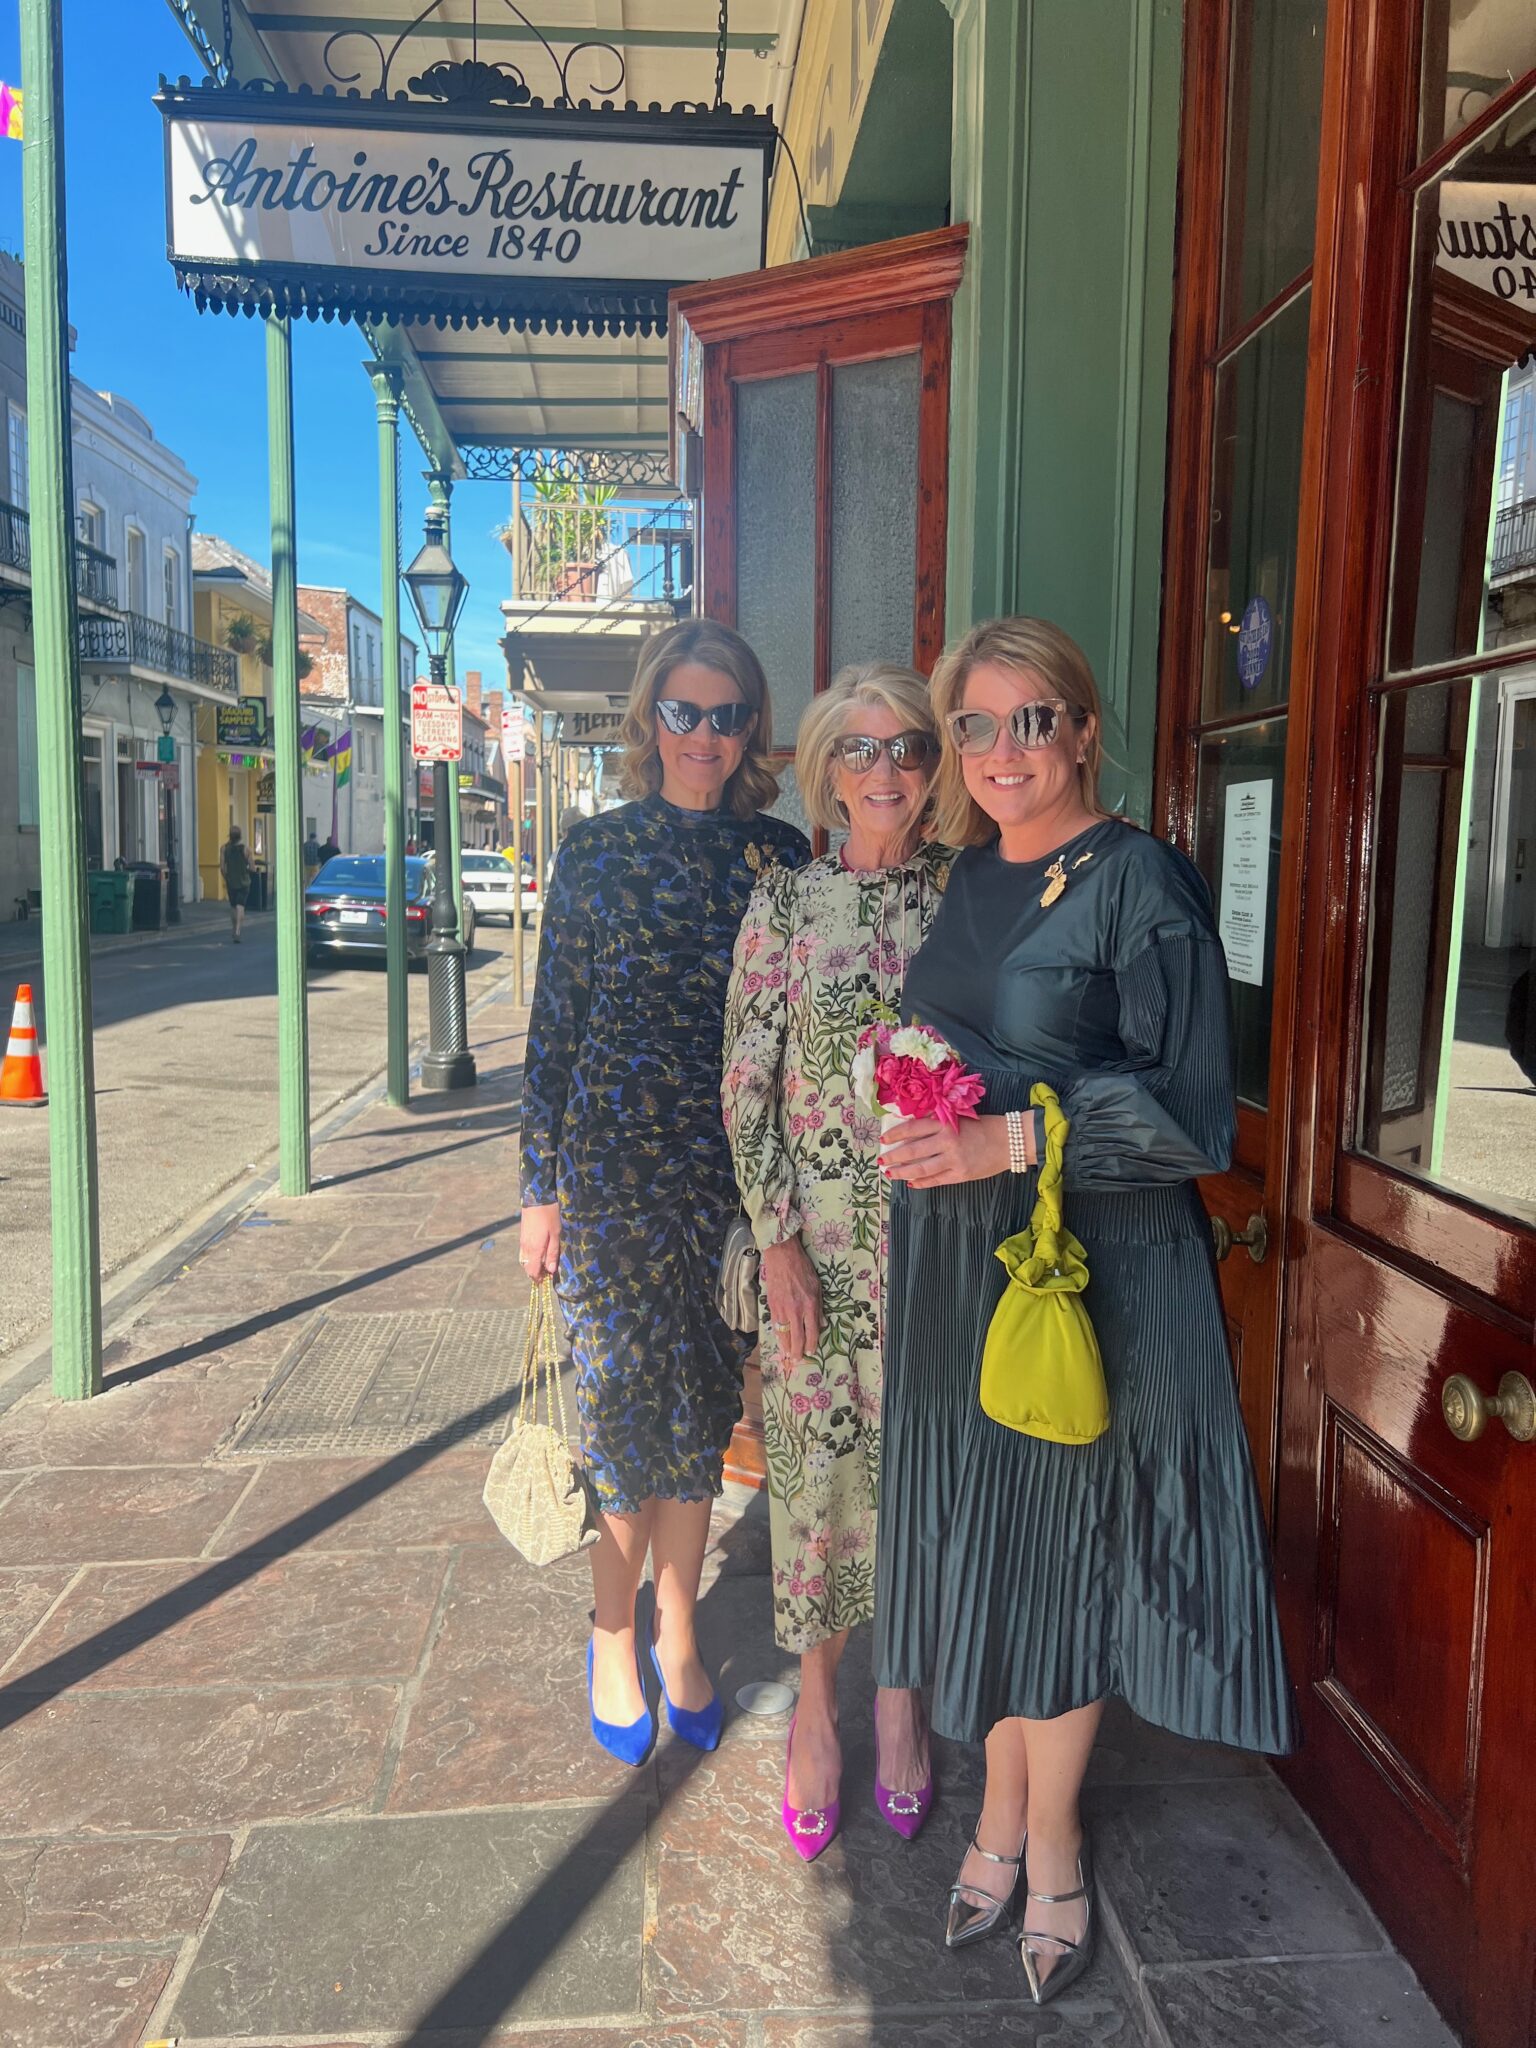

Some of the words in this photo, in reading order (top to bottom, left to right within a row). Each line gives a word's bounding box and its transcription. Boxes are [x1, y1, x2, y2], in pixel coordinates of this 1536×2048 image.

[189, 137, 458, 216] Antoine's
[457, 148, 745, 230] Restaurant
[363, 219, 470, 258] Since
[486, 225, 582, 264] 1840
[413, 690, 428, 705] NO
[418, 720, 456, 728] TUESDAYS
[422, 728, 451, 736] STREET
[416, 735, 457, 743] CLEANING
